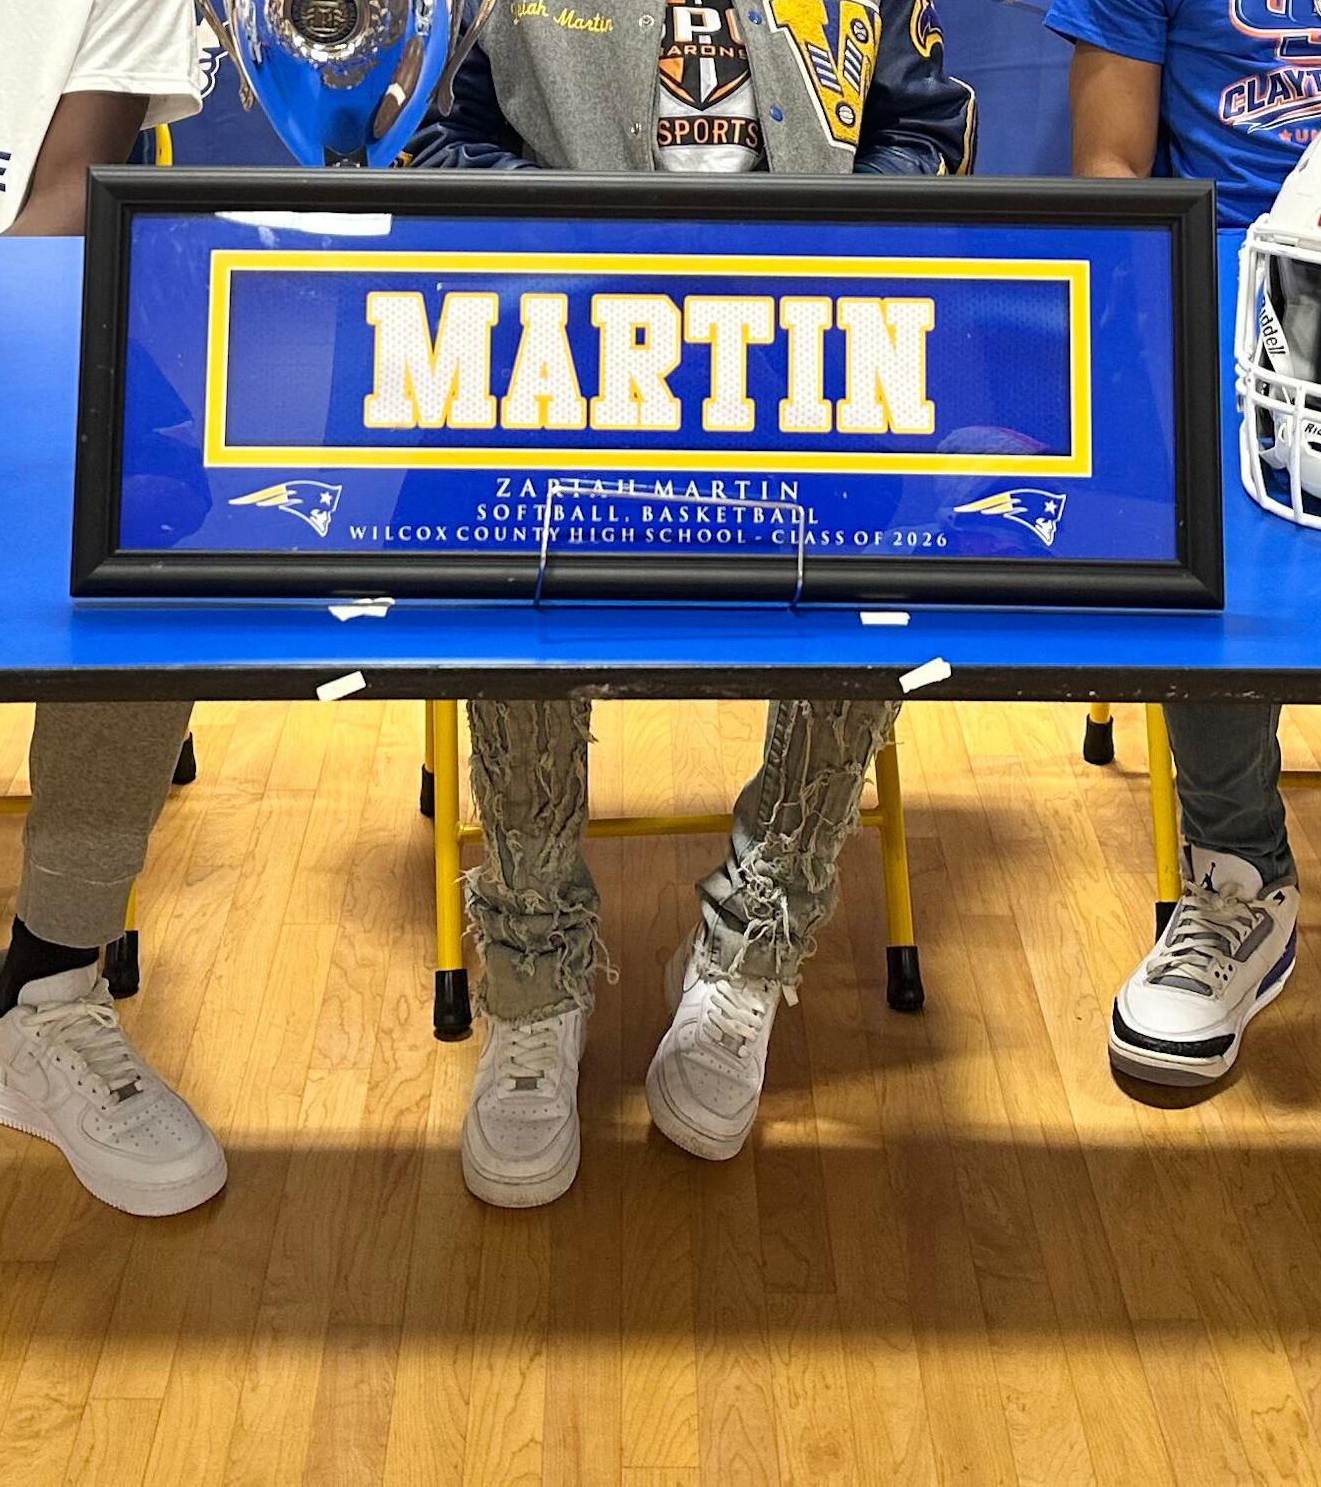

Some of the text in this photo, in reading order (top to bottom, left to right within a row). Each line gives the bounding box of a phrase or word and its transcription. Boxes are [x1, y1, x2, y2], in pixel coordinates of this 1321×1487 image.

[552, 7, 614, 33] Martin
[362, 290, 936, 435] MARTIN
[495, 477, 799, 500] ZARIAH MARTIN
[641, 506, 819, 524] BASKETBALL
[350, 525, 448, 541] WILCOX
[456, 526, 560, 542] COUNTY
[569, 527, 635, 543] HIGH
[645, 527, 746, 544] SCHOOL
[771, 529, 845, 545] CLASS
[853, 530, 882, 545] OF
[892, 531, 948, 547] 2026
